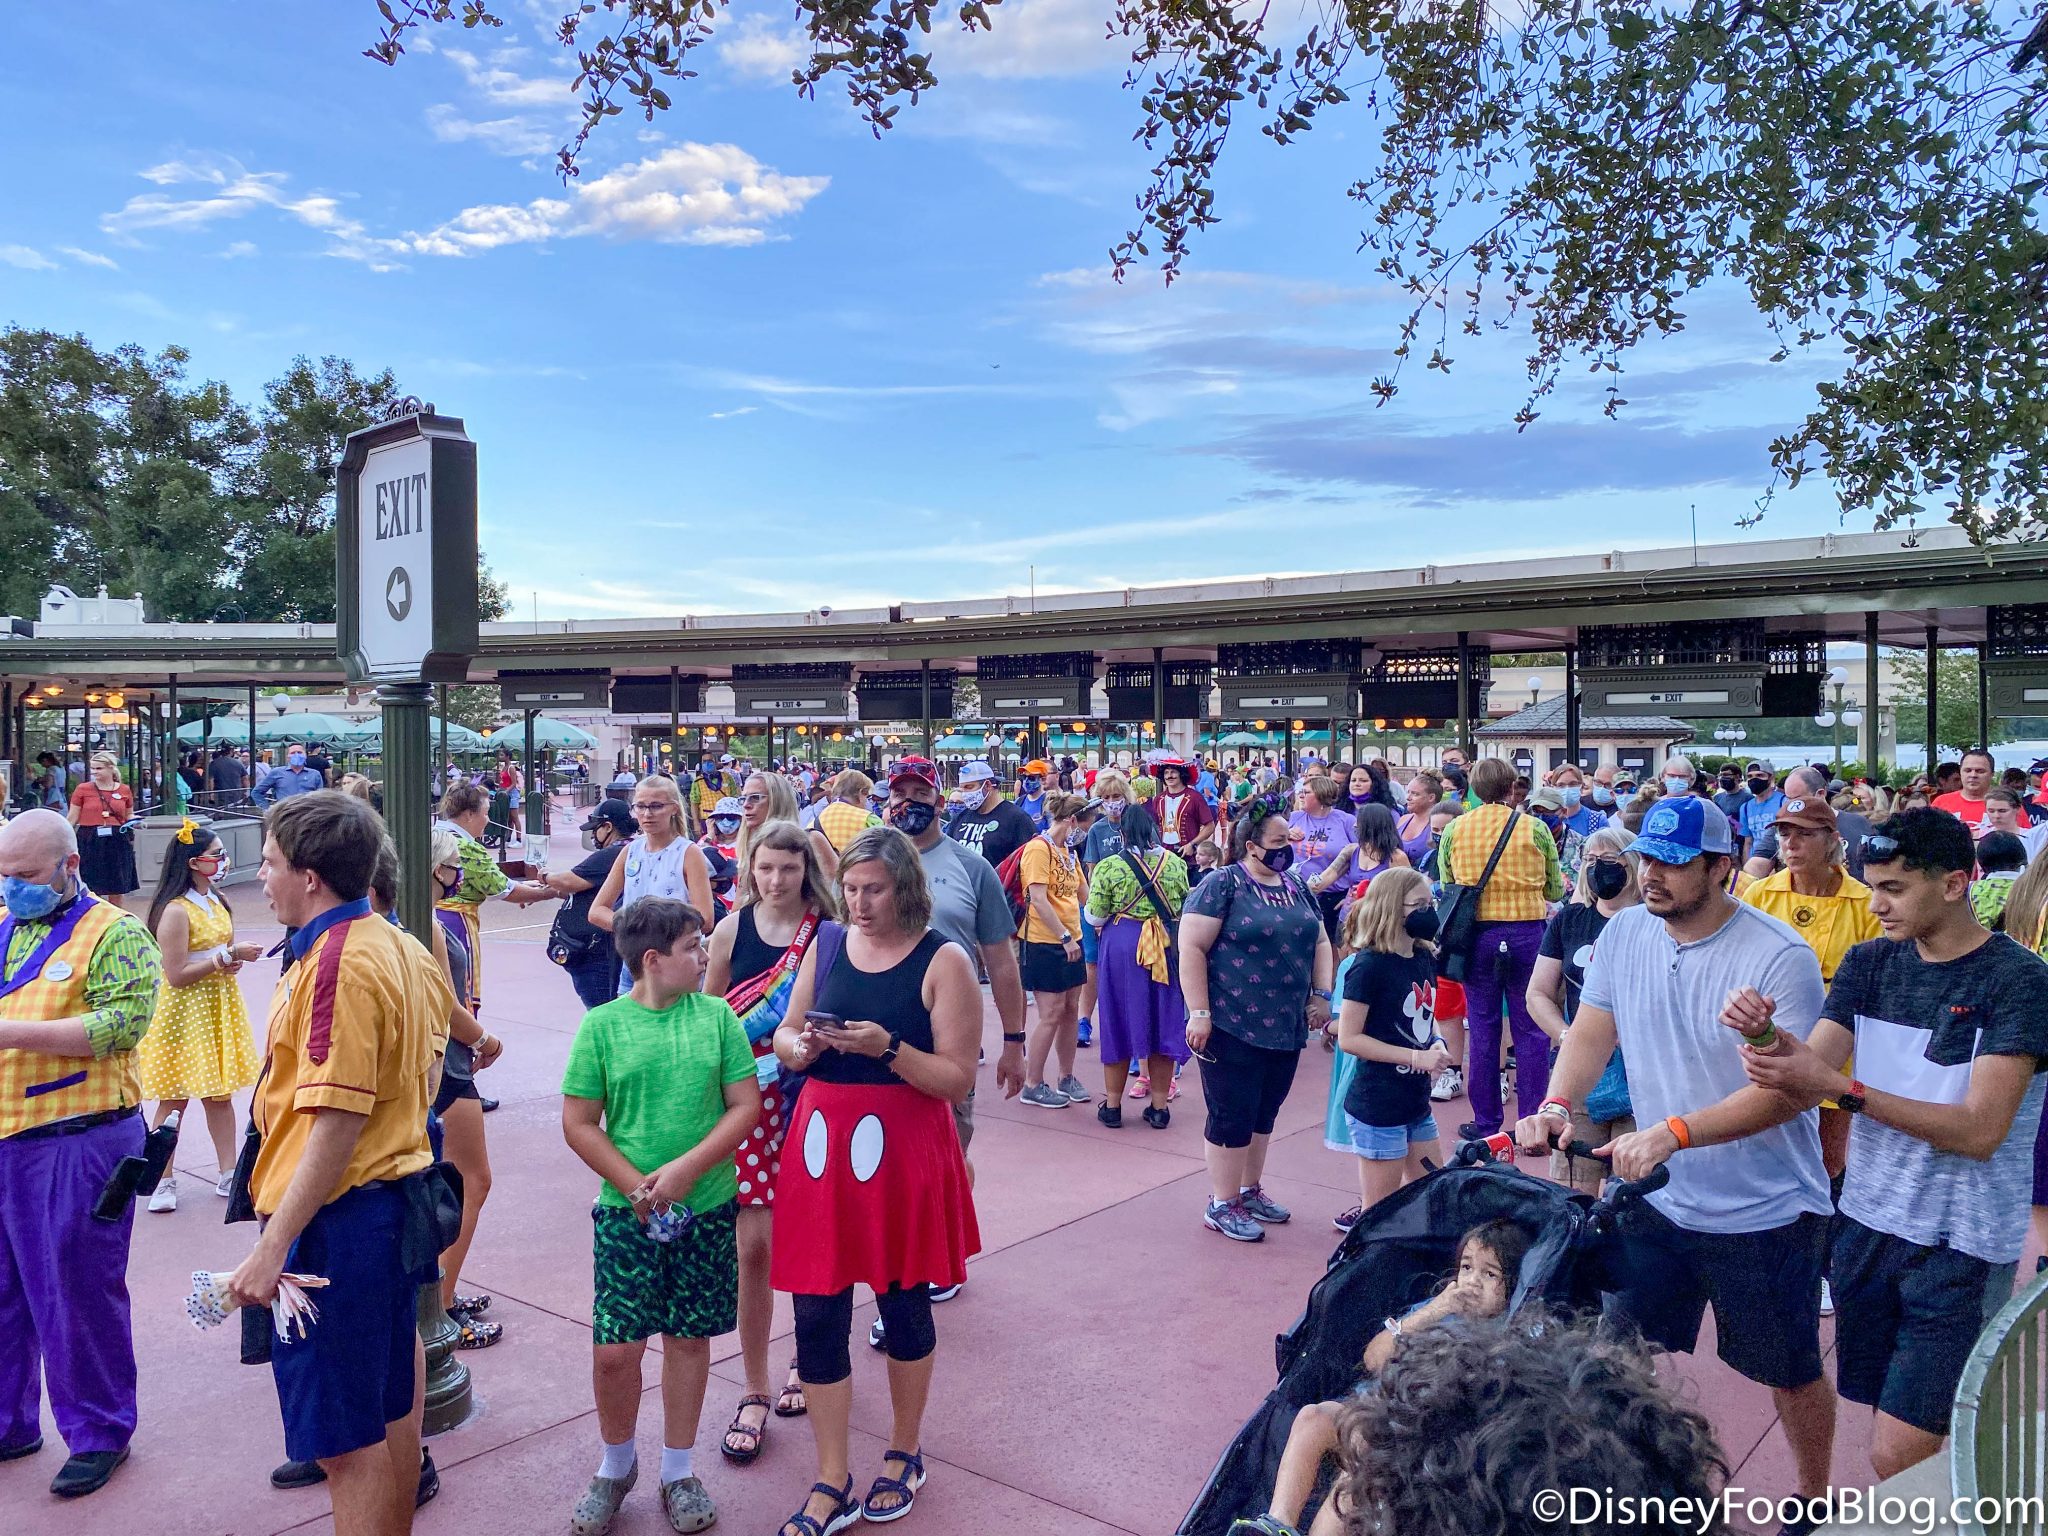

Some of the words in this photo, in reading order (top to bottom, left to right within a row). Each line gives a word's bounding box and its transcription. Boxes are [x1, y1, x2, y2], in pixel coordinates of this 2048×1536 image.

[375, 472, 427, 541] EXIT
[1281, 698, 1295, 706] EXIT
[1664, 693, 1683, 702] EXIT
[963, 823, 988, 841] THE
